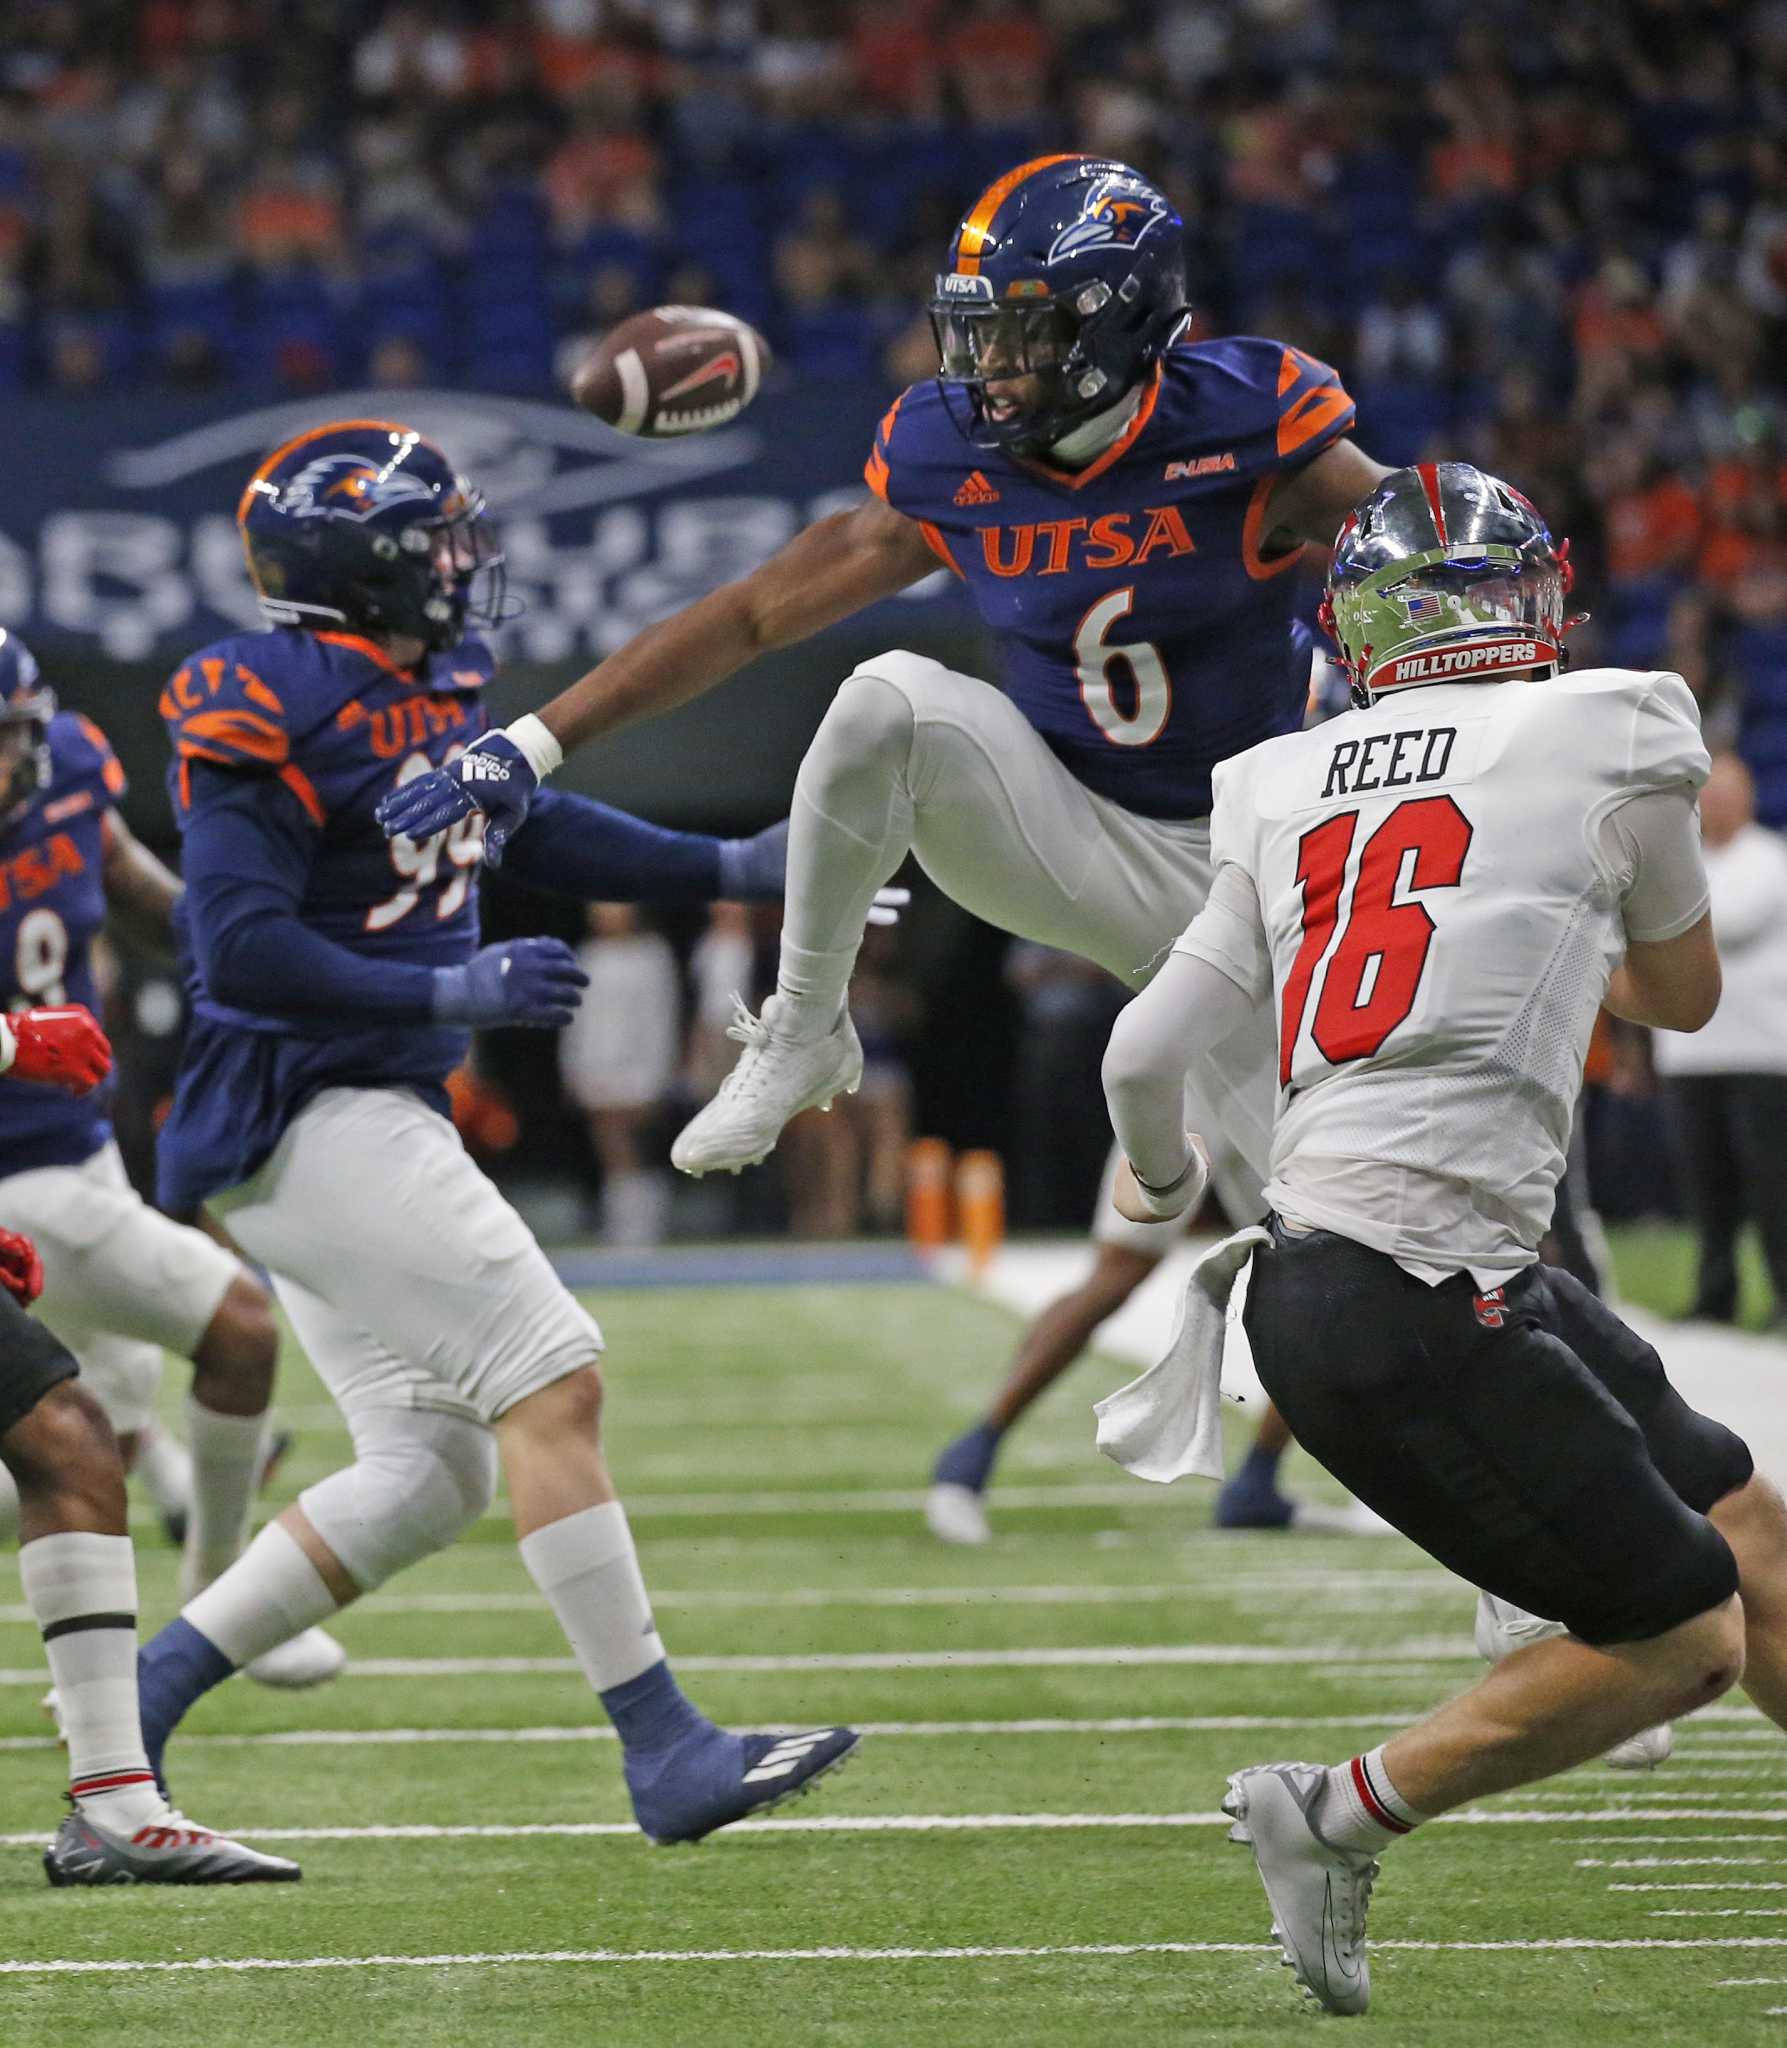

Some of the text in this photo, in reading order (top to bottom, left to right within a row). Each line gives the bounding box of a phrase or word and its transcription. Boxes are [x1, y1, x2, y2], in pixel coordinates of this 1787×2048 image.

[944, 277, 977, 293] UTSA
[976, 505, 1196, 577] UTSA
[1073, 586, 1172, 746] 6
[1395, 643, 1536, 681] HILLTOPPERS
[1320, 727, 1457, 799] REED
[1280, 793, 1474, 1093] 16
